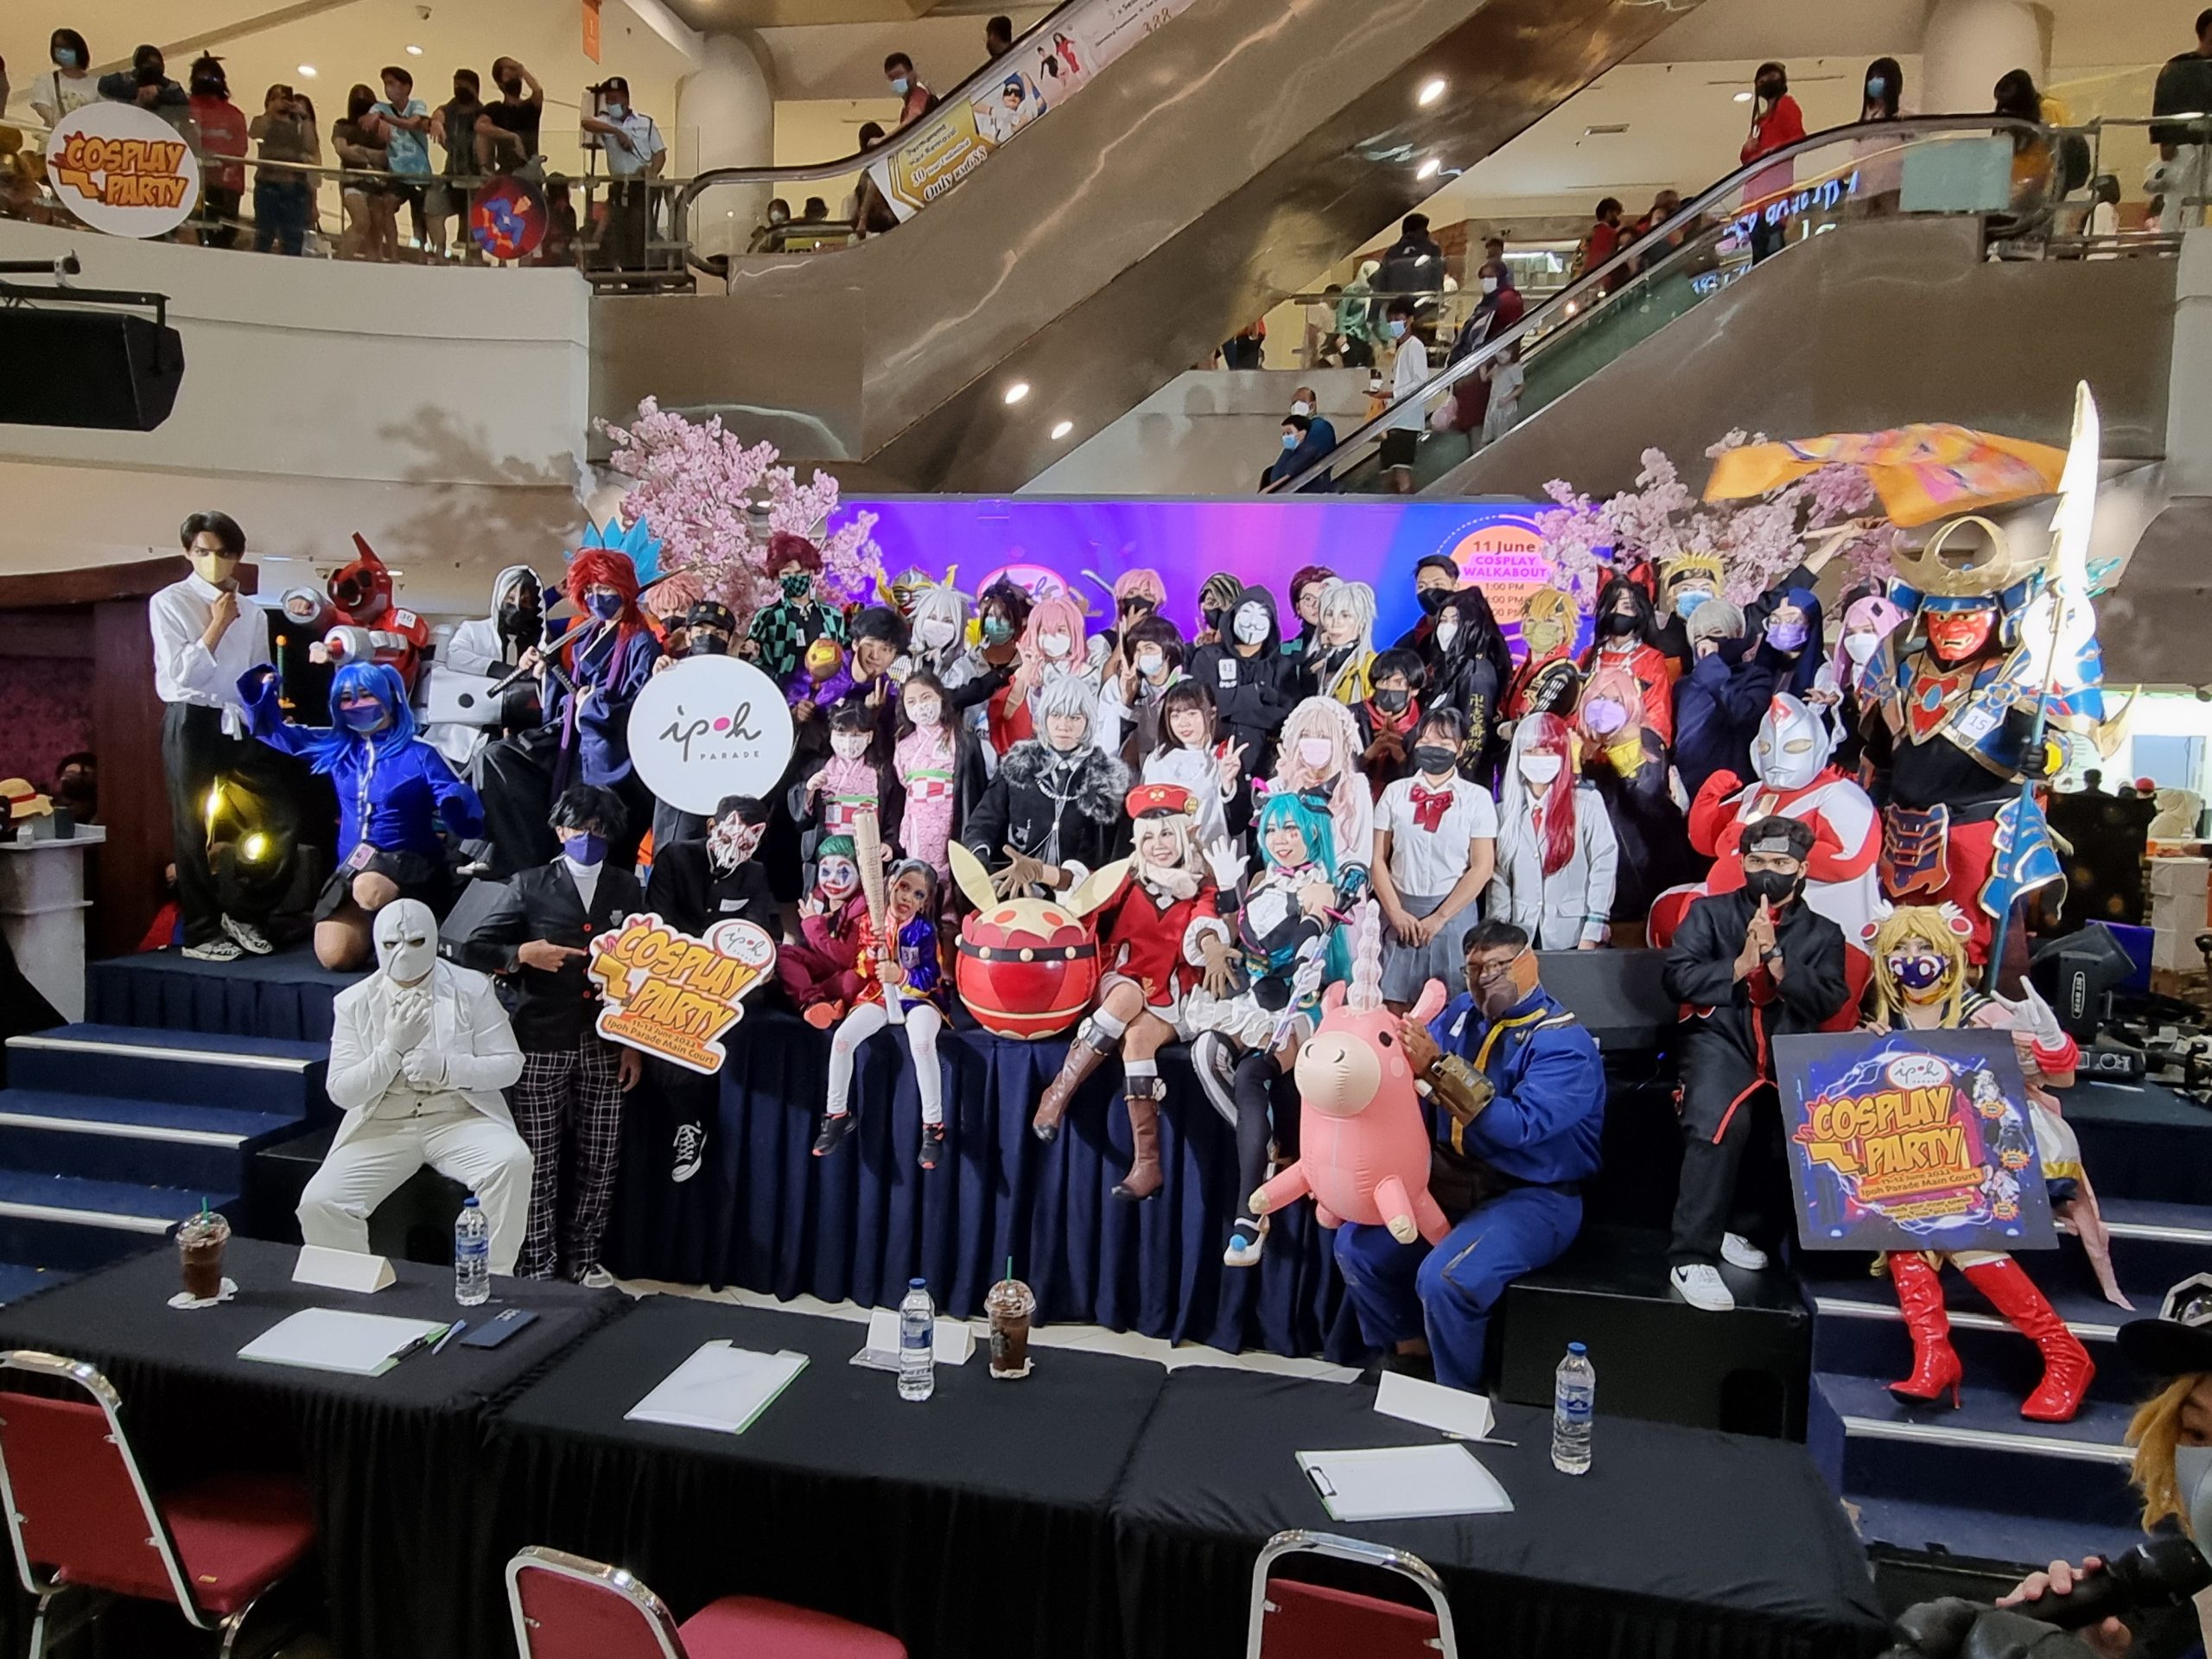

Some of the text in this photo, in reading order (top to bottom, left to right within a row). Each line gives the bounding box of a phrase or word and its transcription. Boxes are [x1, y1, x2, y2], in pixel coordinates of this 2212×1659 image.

[66, 137, 187, 174] COSPLAY
[105, 173, 189, 208] PARTY
[924, 173, 952, 201] Only
[1472, 540, 1535, 555] 11 June
[1464, 568, 1547, 577] WALKABOUT
[1475, 556, 1536, 566] COSPLAY
[1485, 582, 1524, 591] 1:00 PM
[1486, 595, 1505, 604] :00
[658, 702, 762, 762] ipoh
[1969, 715, 1988, 731] 15
[700, 750, 760, 760] PARADE
[614, 925, 760, 1000] COSPLAY
[626, 977, 740, 1041] PARTY
[607, 1019, 715, 1065] Ipoh Parade Main Court
[654, 1027, 673, 1039] June
[1894, 1060, 1940, 1084] ipoh
[1813, 1086, 1953, 1141] COSPLAY
[1864, 1126, 1965, 1178] PARTY
[1861, 1187, 1885, 1198] Ipoh
[1886, 1181, 1920, 1192] Parade
[1949, 1172, 1979, 1183] Court
